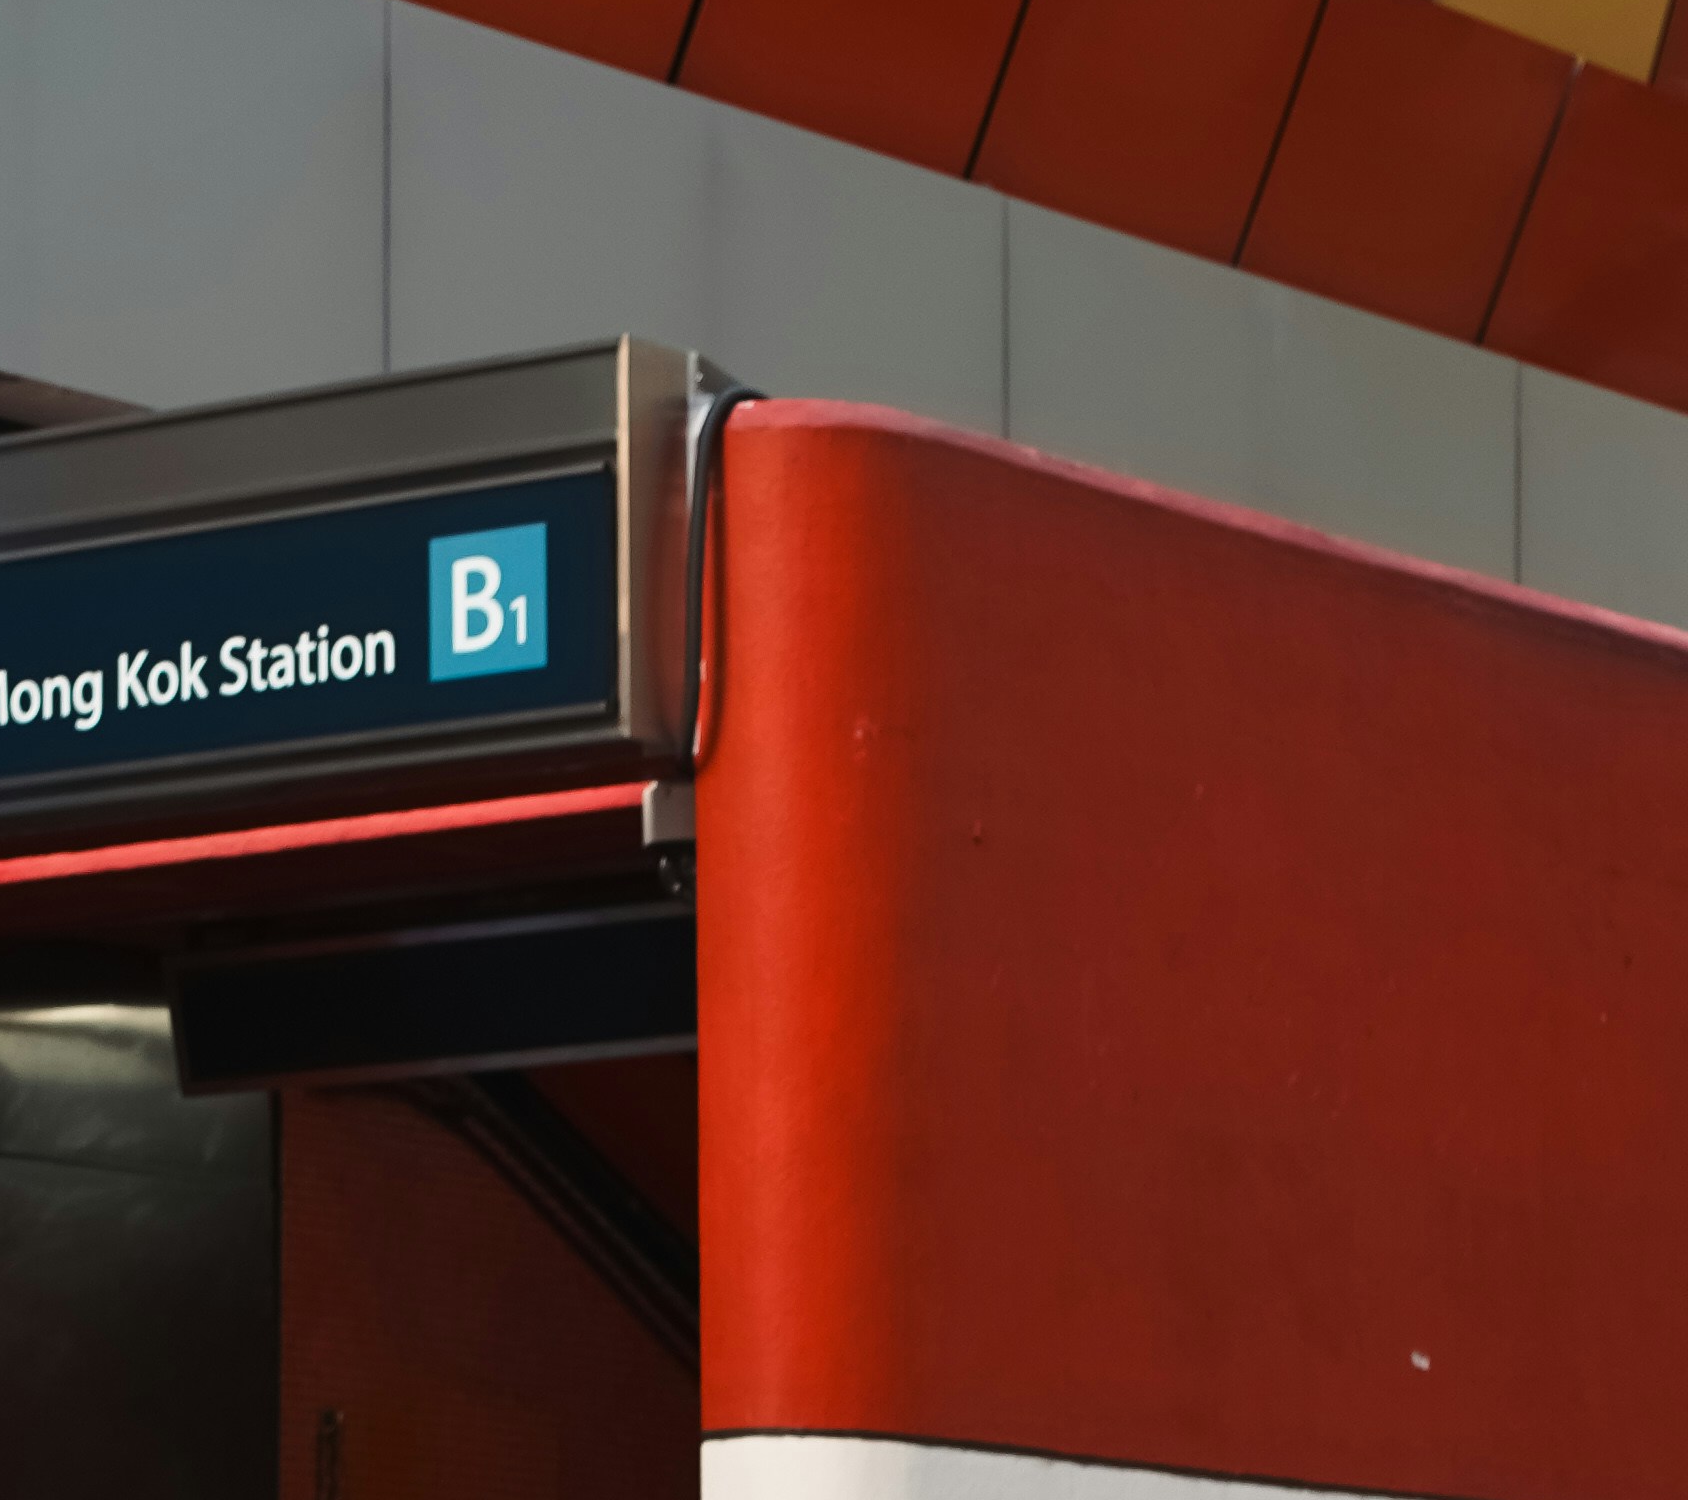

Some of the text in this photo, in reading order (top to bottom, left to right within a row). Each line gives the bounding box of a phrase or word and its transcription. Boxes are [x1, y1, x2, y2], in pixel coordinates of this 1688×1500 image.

[451, 554, 528, 654] B1
[116, 640, 210, 711] Kok
[218, 623, 397, 697] Station
